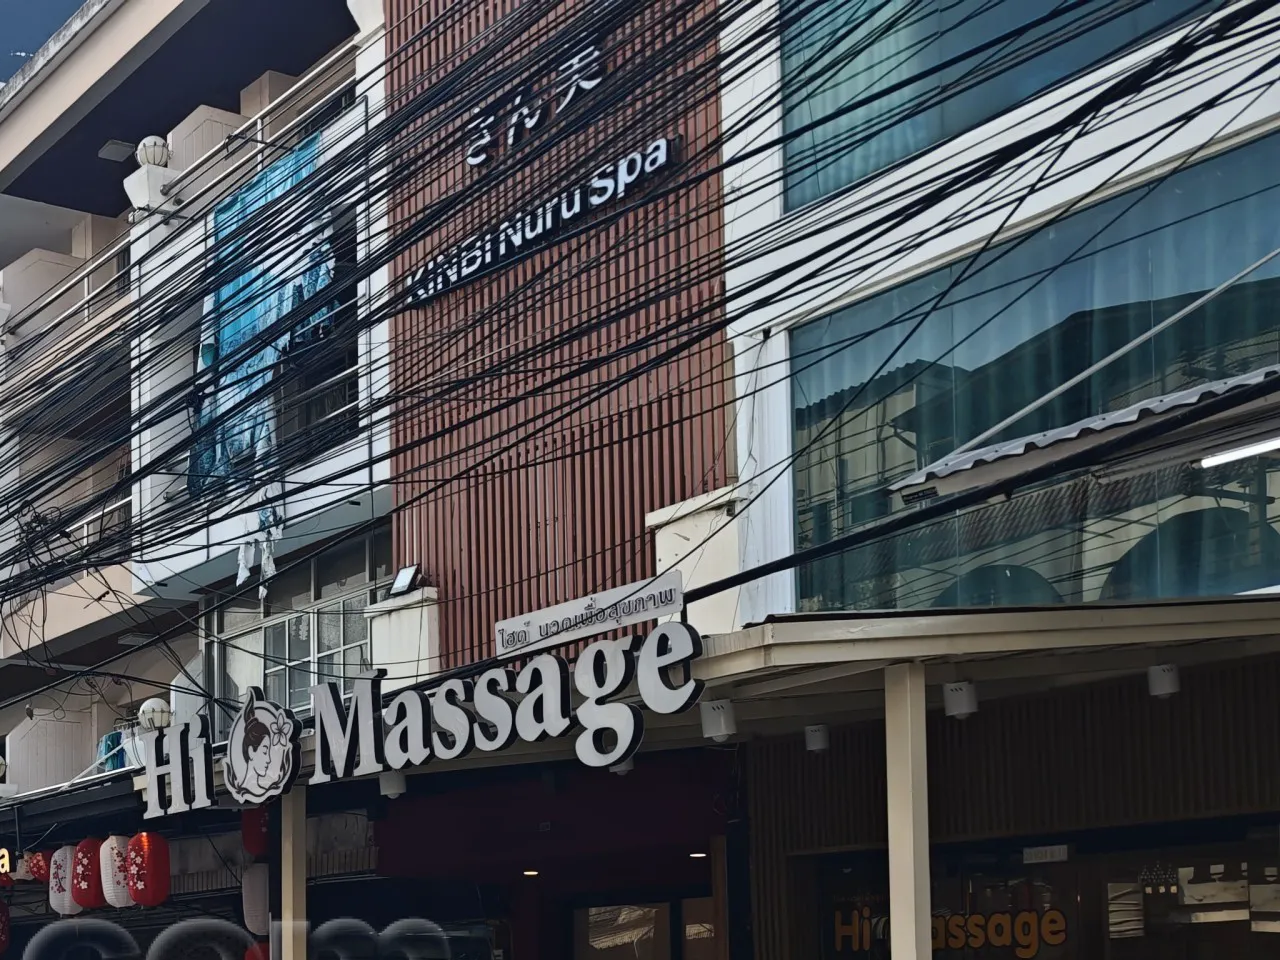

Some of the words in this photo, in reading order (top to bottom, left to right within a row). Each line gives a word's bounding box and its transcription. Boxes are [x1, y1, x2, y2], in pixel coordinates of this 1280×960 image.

[499, 188, 581, 256] Nuru
[588, 137, 668, 206] Spa
[538, 586, 677, 638] นวดเพื่อสุขภาพ
[141, 712, 217, 820] Hi
[307, 620, 705, 785] Massage
[834, 905, 872, 952] Hi
[932, 908, 1068, 960] assage
